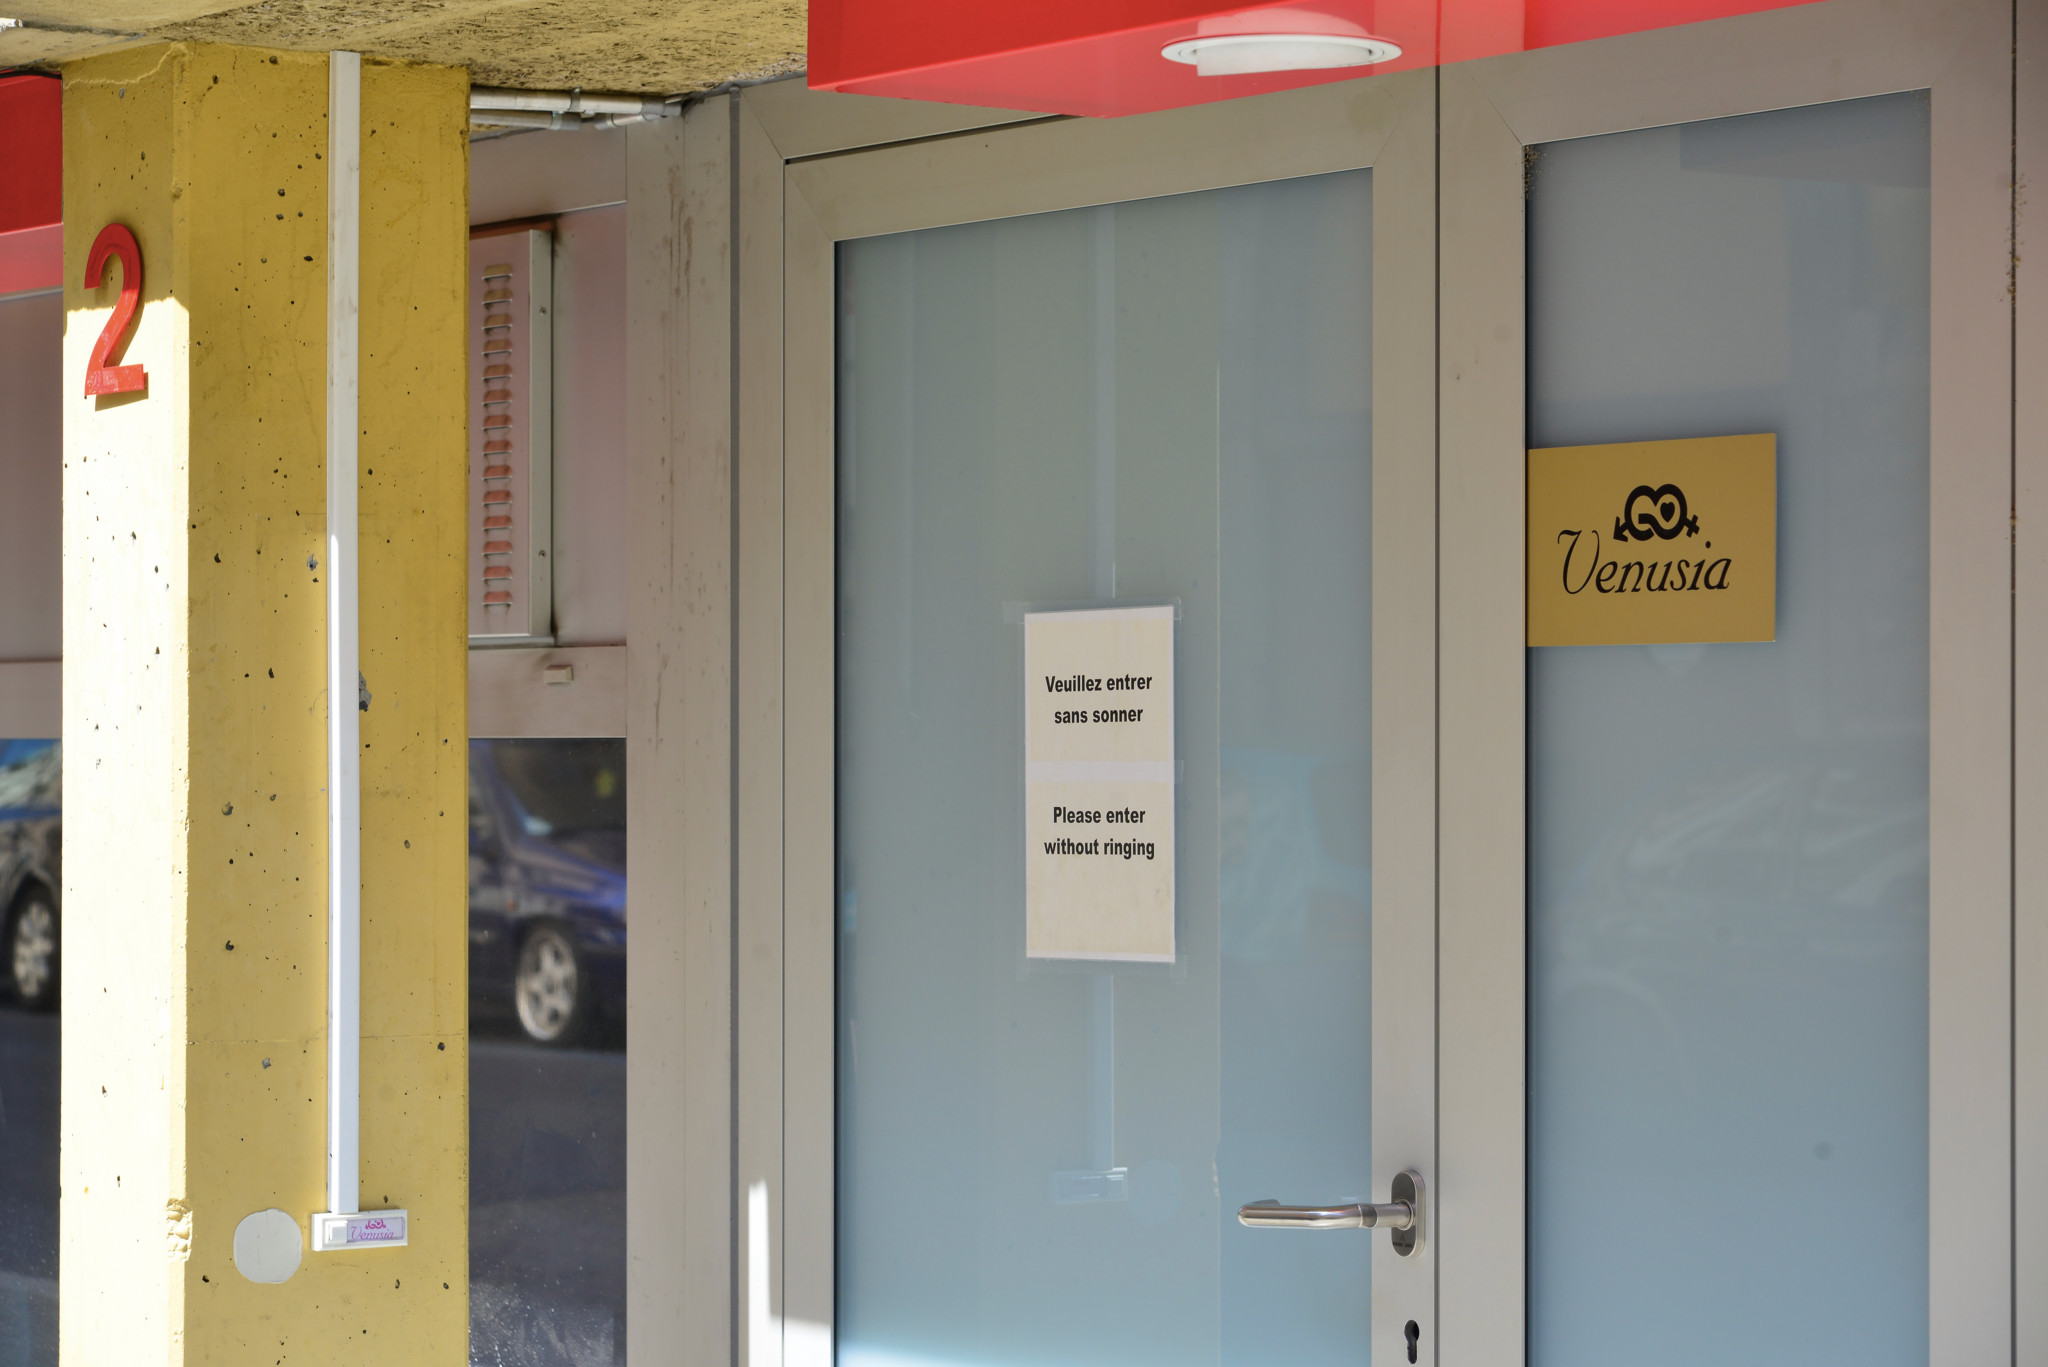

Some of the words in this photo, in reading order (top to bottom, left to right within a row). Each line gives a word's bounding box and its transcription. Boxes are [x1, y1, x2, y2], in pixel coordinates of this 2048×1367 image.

[84, 223, 145, 396] 2
[1557, 529, 1732, 595] Venusia
[1045, 674, 1102, 693] Veuillez
[1106, 673, 1153, 691] entrer
[1054, 709, 1088, 724] sans
[1092, 708, 1144, 723] sonner
[1053, 806, 1102, 824] Please
[1106, 806, 1146, 824] enter
[1044, 838, 1099, 856] without
[1103, 838, 1155, 861] ringing
[350, 1226, 395, 1240] Venusia
